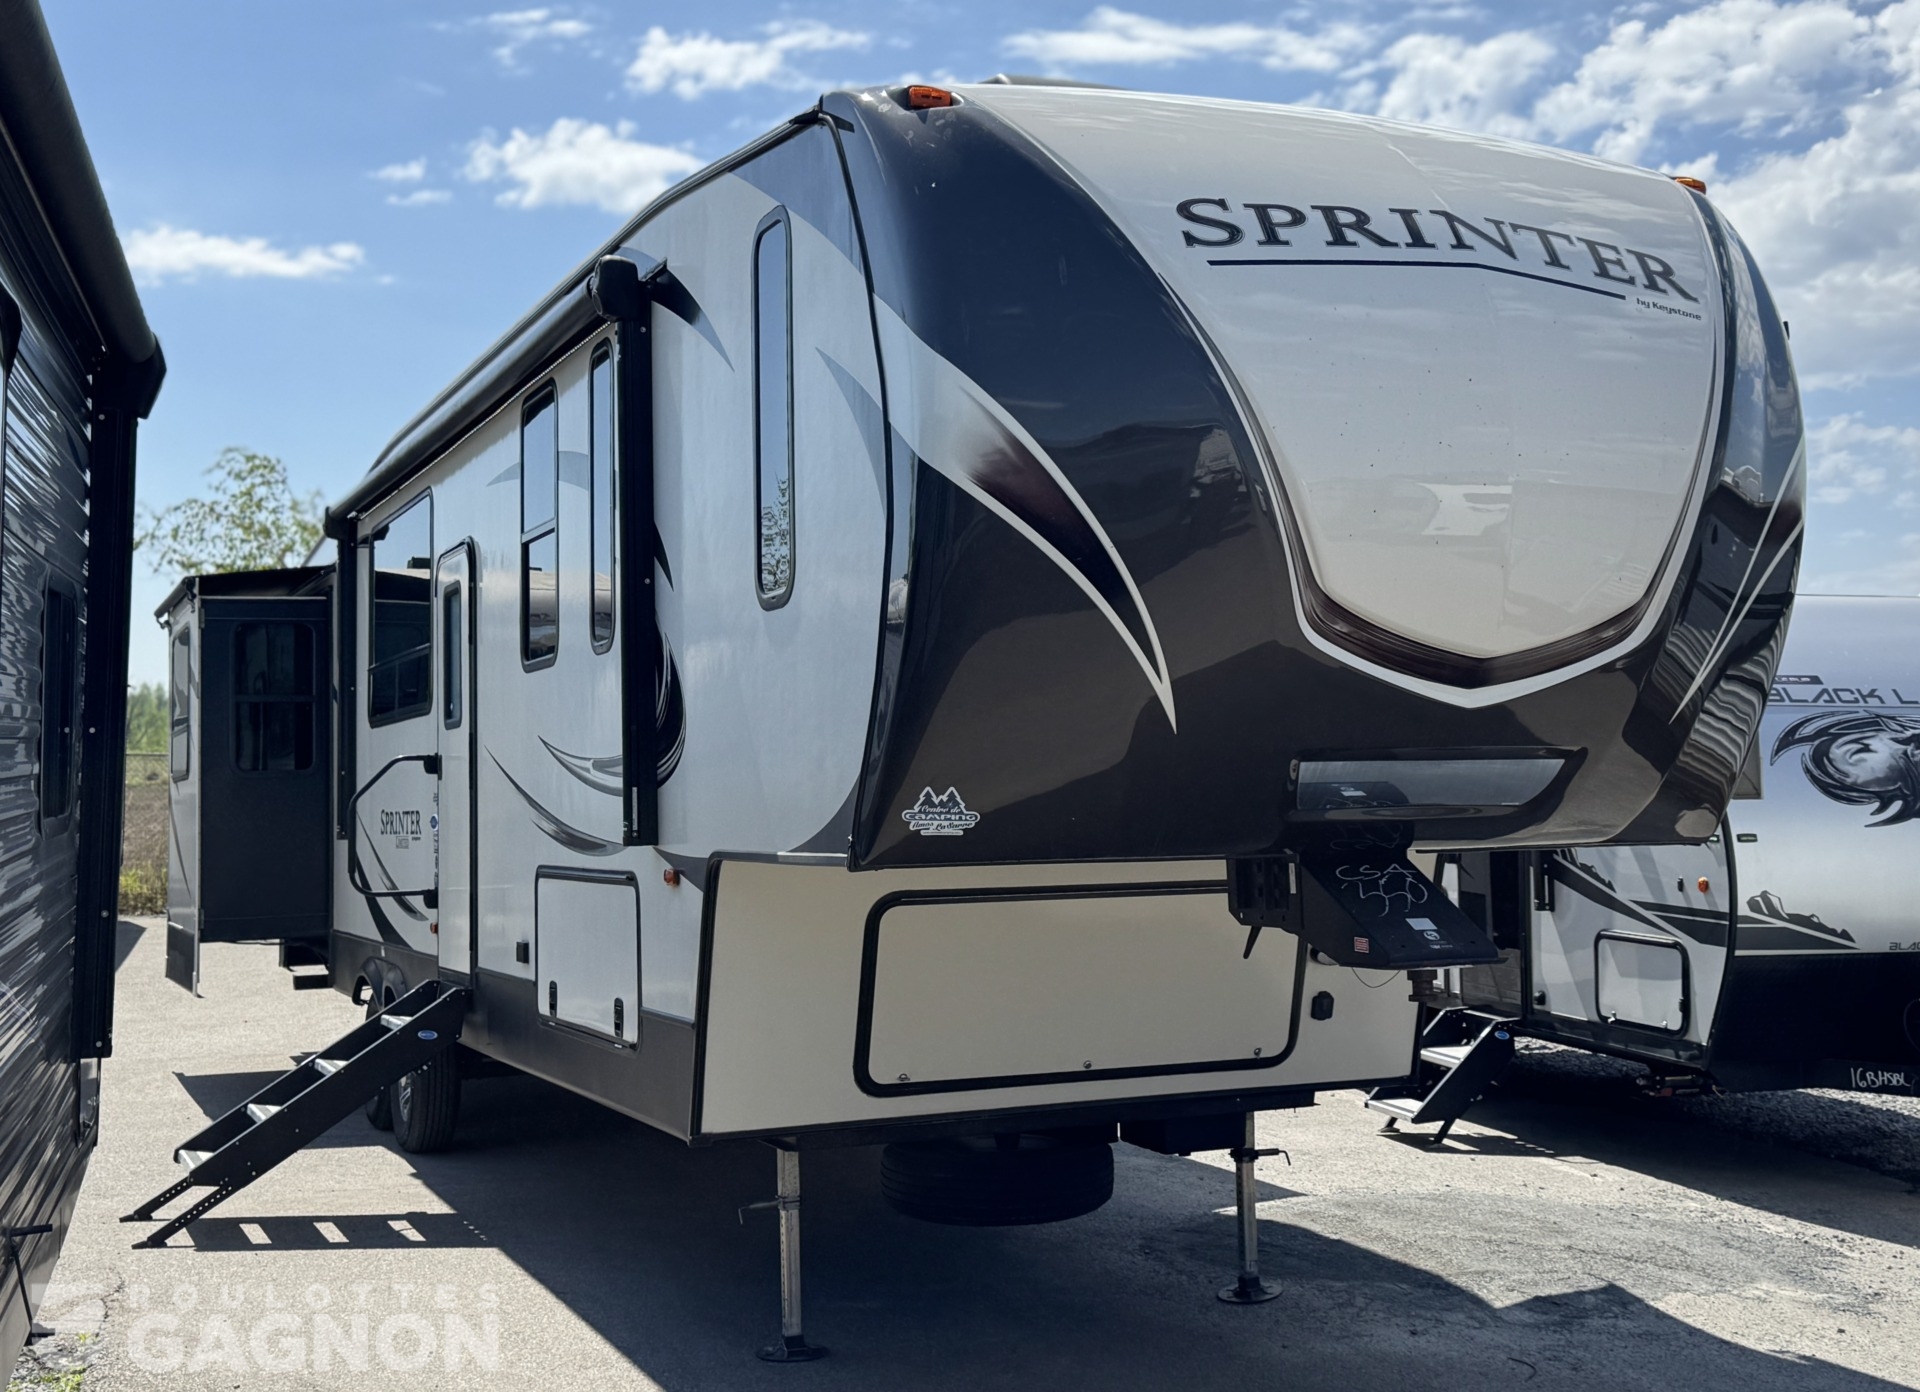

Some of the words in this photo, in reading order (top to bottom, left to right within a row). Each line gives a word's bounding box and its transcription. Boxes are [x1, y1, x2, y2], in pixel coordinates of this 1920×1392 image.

[1176, 197, 1700, 304] SPRINTER
[1636, 297, 1651, 309] by
[1652, 301, 1702, 321] Keystone
[1768, 687, 1885, 704] BLACK
[380, 809, 421, 835] SPRINTER
